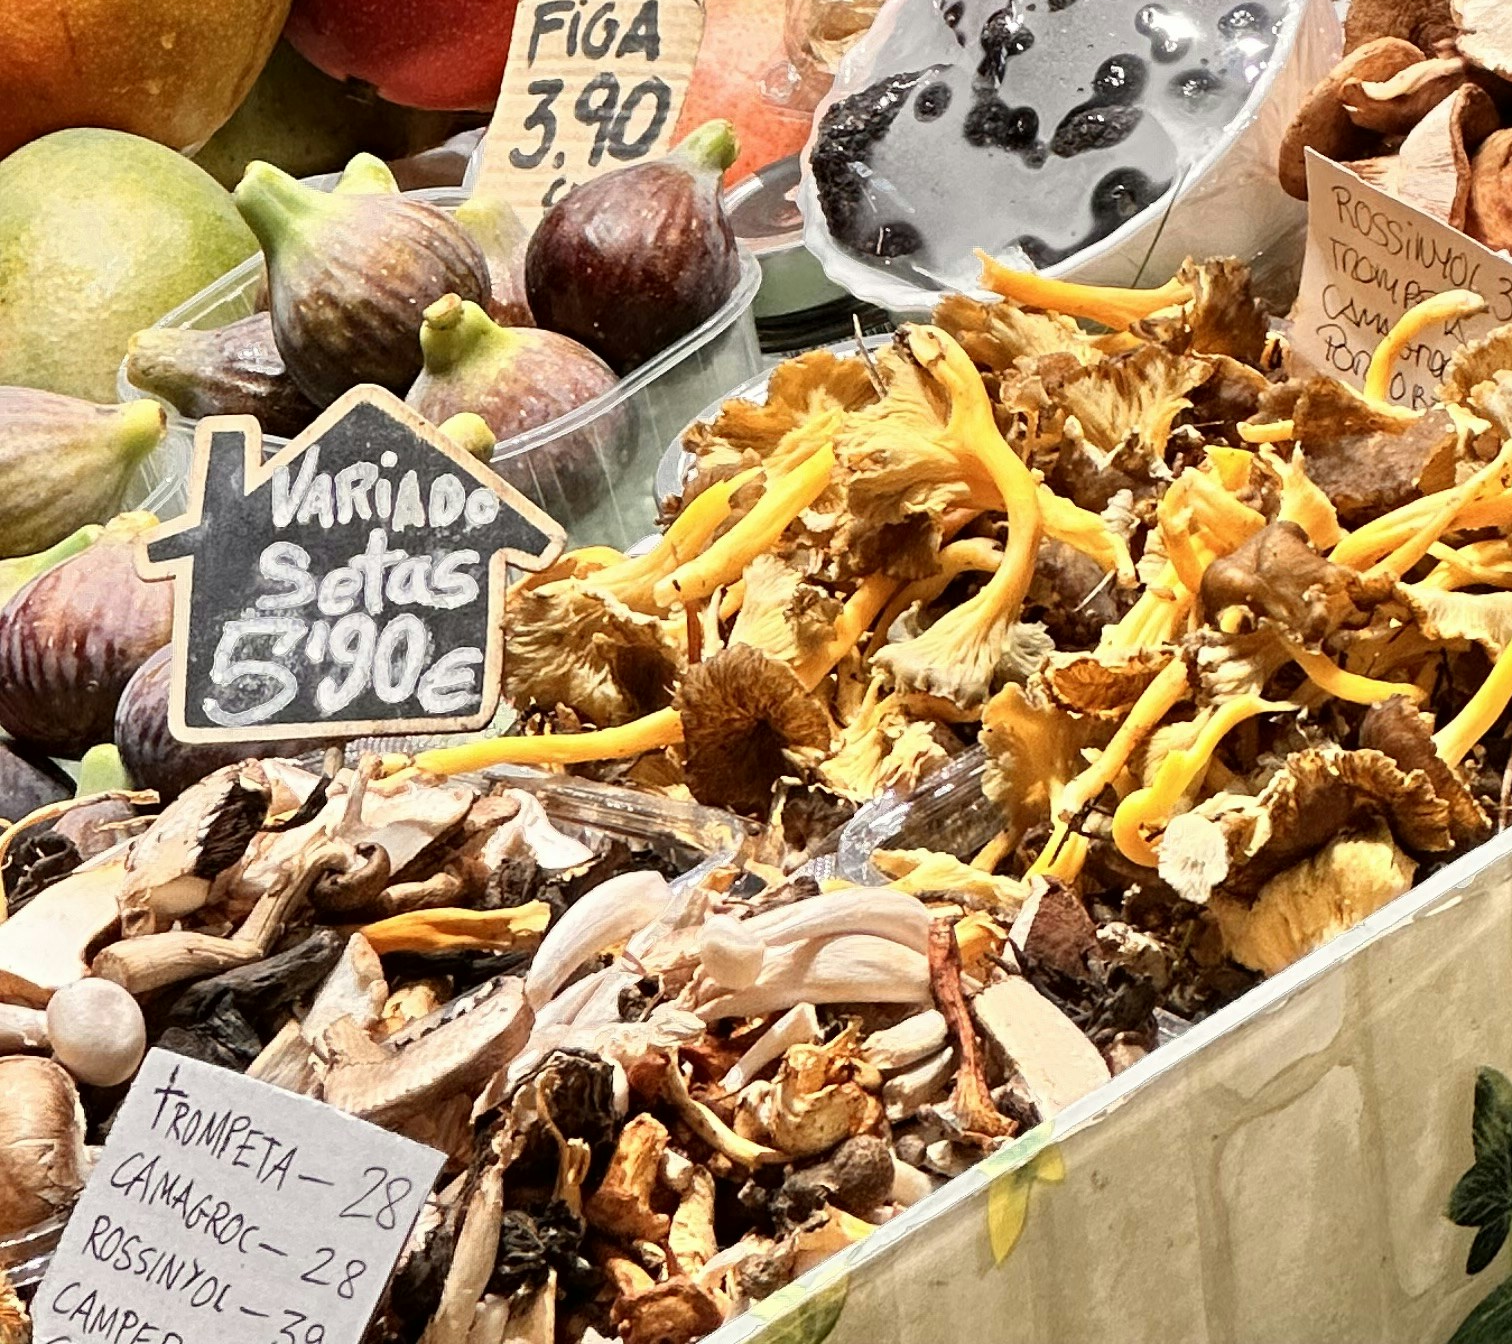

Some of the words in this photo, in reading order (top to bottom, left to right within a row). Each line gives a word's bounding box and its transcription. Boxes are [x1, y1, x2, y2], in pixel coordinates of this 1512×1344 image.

[255, 526, 482, 615] Setas
[109, 1151, 260, 1255] CAMAGROC
[300, 1247, 367, 1300] 28
[338, 1166, 413, 1231] 28
[81, 1214, 233, 1313] ROSSINYOL
